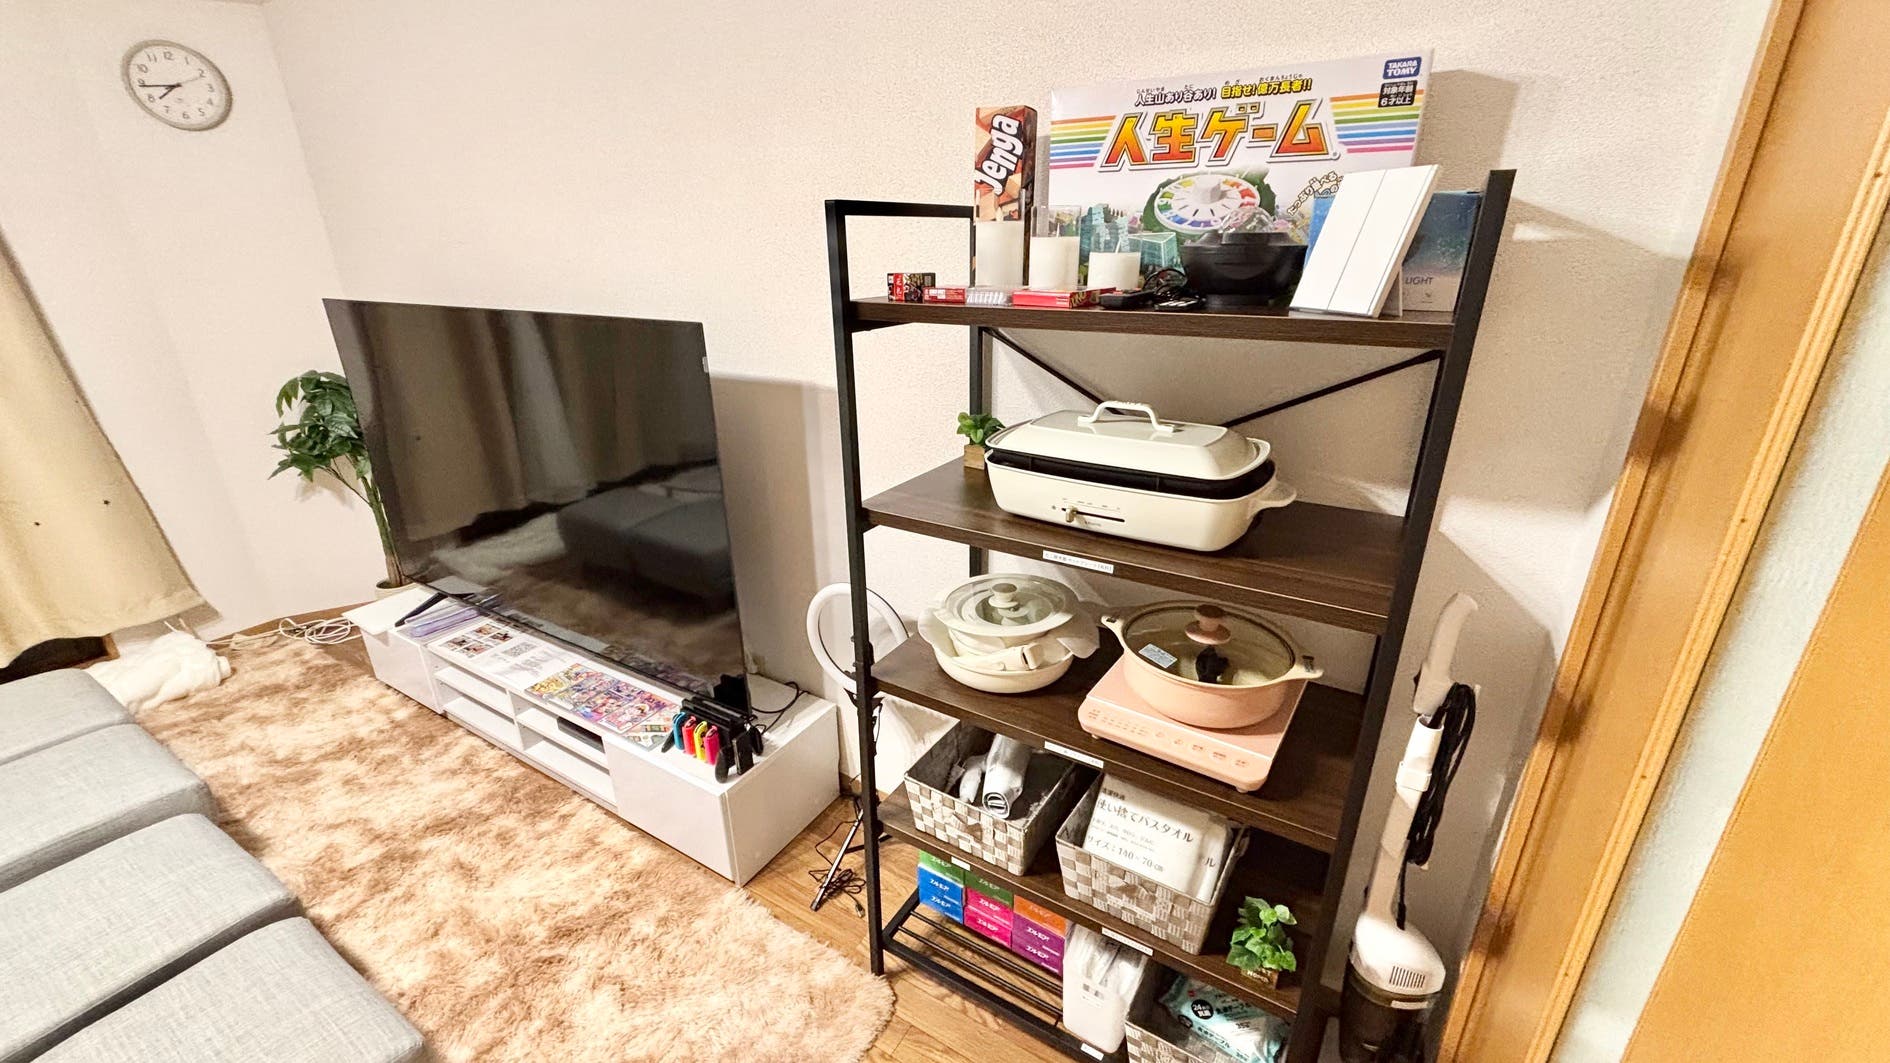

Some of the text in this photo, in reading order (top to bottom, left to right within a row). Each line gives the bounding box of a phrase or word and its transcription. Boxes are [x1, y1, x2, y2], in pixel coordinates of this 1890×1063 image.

[1388, 60, 1418, 69] TAKARA
[198, 68, 205, 78] 2
[1387, 67, 1418, 77] TOMY
[208, 83, 214, 93] 3
[147, 94, 155, 103] 8
[207, 98, 214, 106] 4
[198, 108, 205, 117] 5
[1099, 99, 1330, 168] 人生ゲーム
[974, 114, 1024, 196] Jenga
